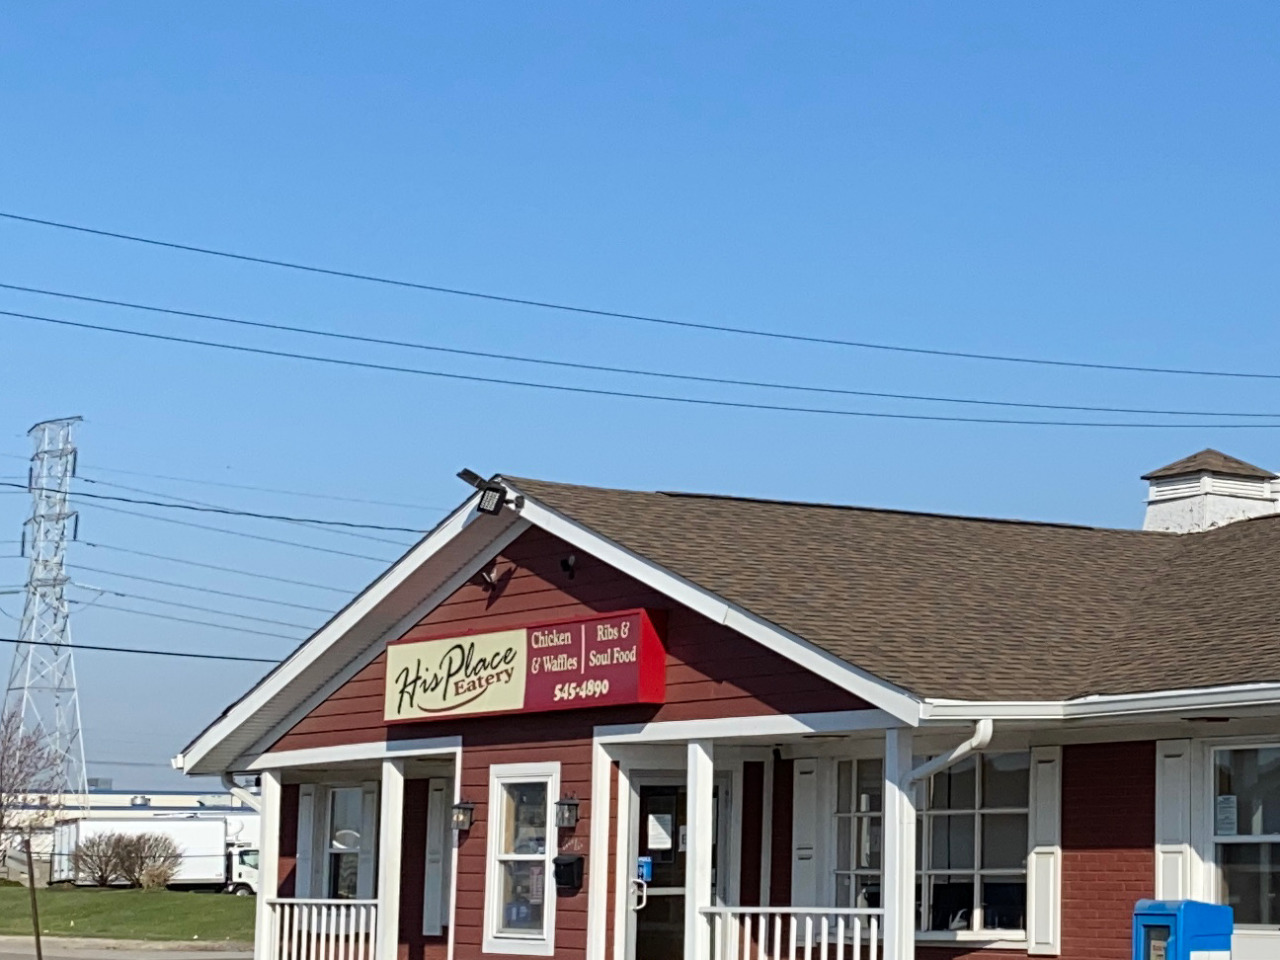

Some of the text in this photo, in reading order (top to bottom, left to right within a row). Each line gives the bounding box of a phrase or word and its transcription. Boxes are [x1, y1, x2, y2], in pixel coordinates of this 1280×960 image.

[531, 629, 572, 649] Chicken
[596, 621, 630, 642] Ribs &
[531, 653, 578, 675] & Waffles
[588, 645, 637, 667] Soul Food
[395, 641, 518, 715] His Place
[453, 666, 515, 697] Eatery
